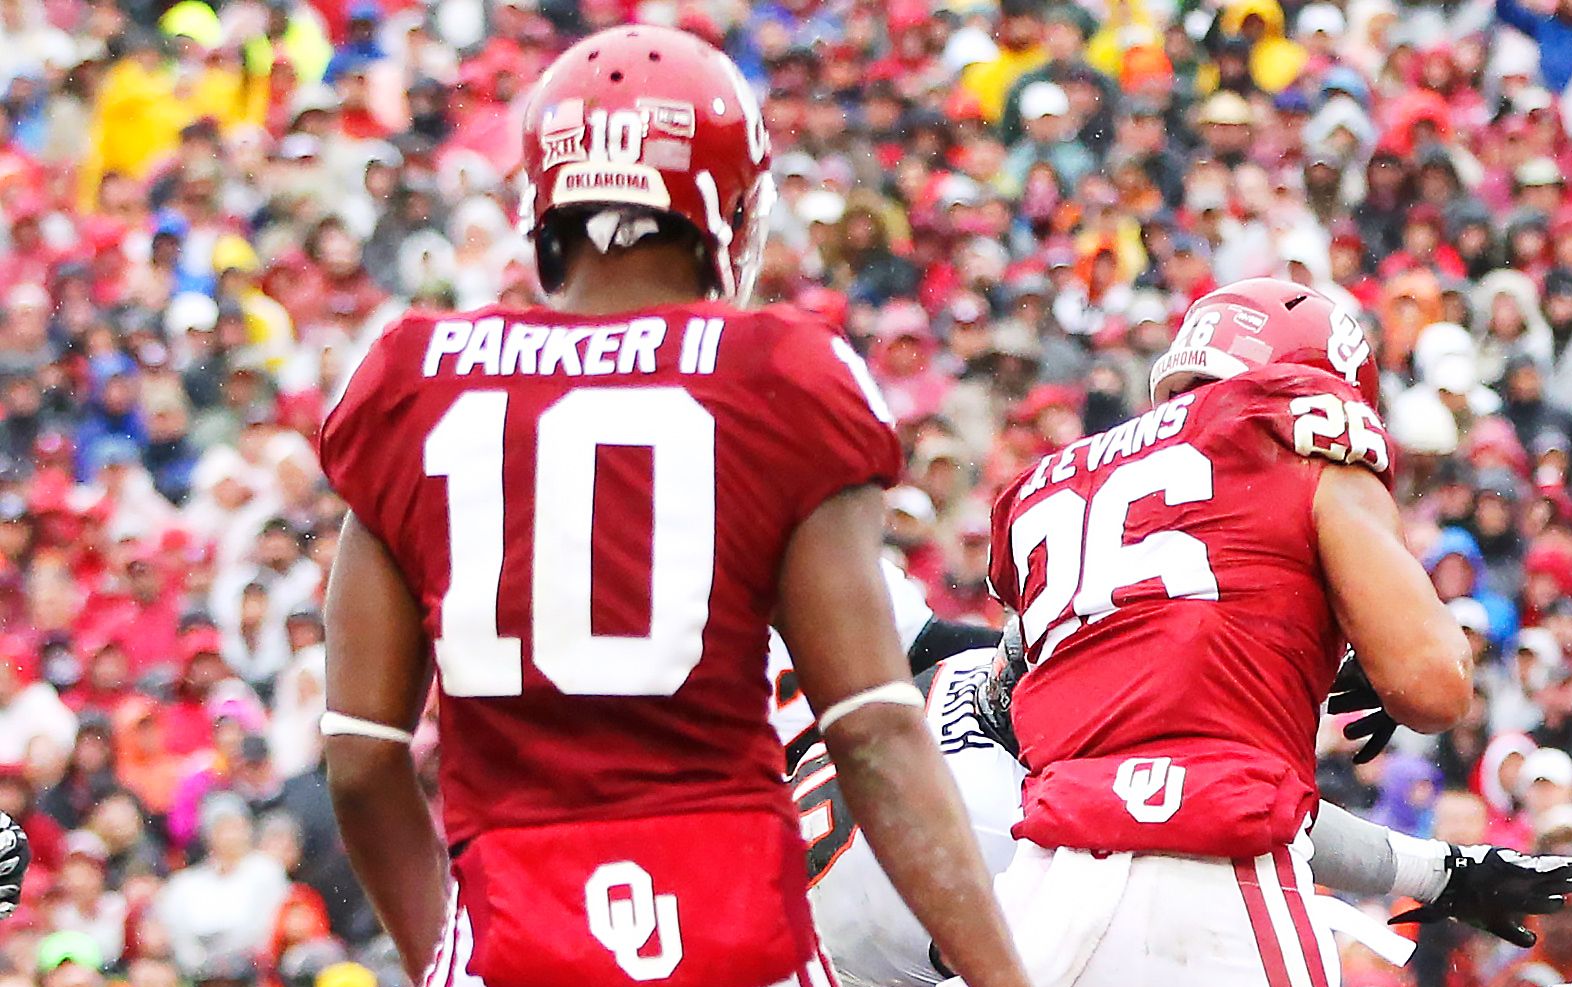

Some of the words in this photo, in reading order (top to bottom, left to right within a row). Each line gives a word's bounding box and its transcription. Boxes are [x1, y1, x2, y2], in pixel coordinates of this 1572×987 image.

[587, 109, 643, 165] 10
[565, 173, 650, 190] OKLAHOMA
[423, 316, 668, 378] PARKER
[679, 317, 726, 375] II
[1289, 393, 1389, 473] 26
[423, 386, 717, 698] 10
[1011, 443, 1220, 673] 26
[1113, 757, 1187, 824] OU
[584, 860, 684, 981] OU
